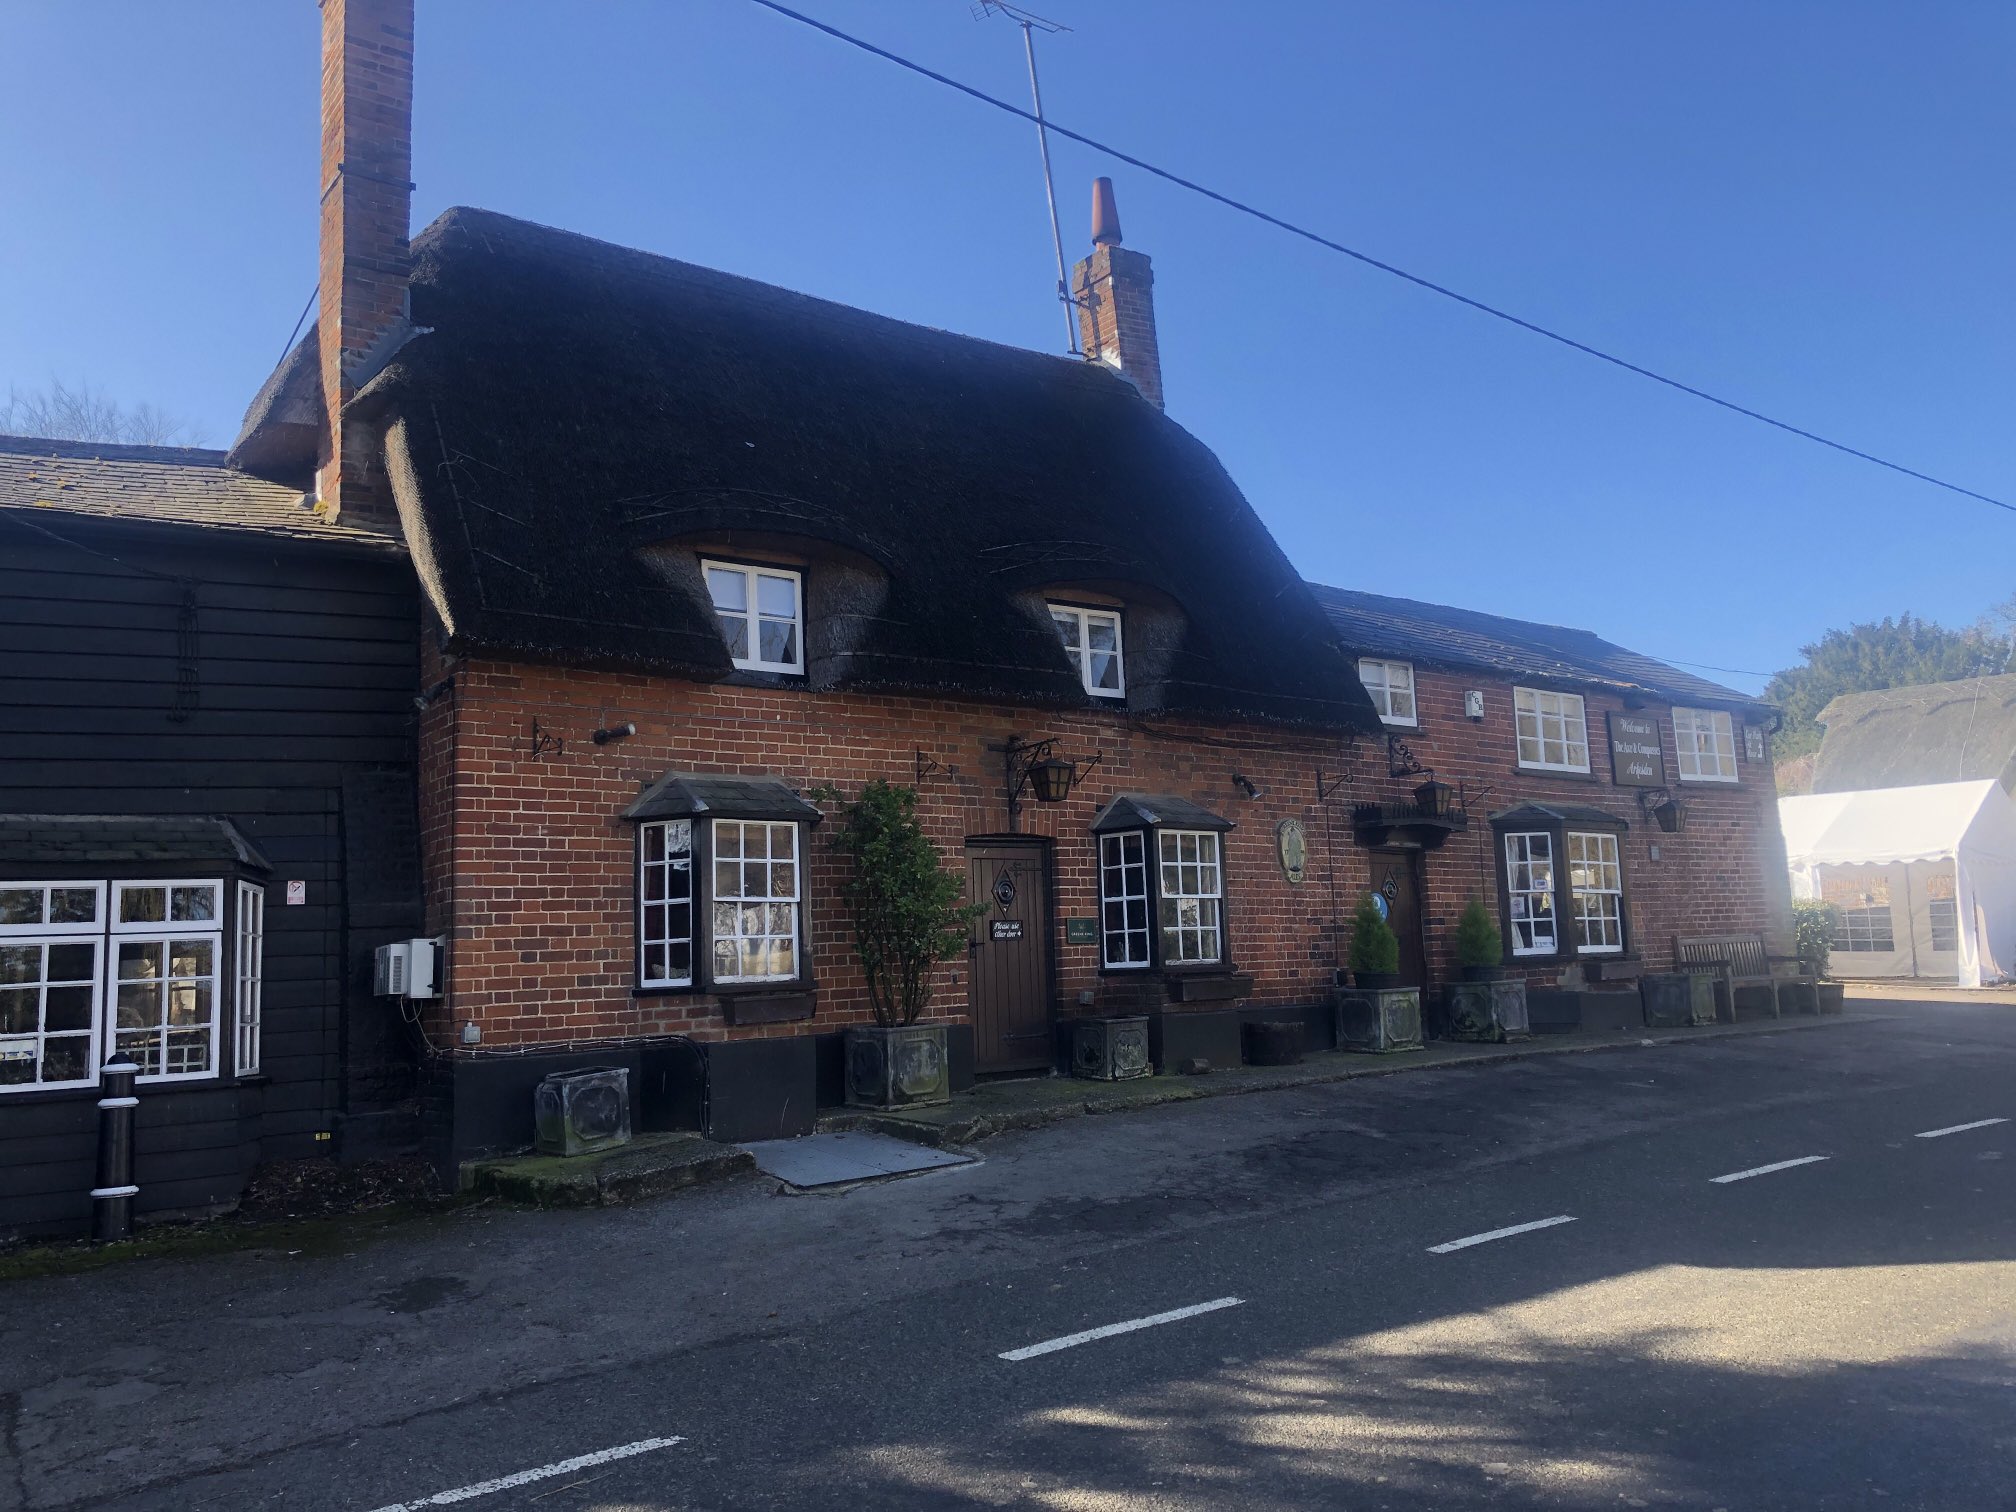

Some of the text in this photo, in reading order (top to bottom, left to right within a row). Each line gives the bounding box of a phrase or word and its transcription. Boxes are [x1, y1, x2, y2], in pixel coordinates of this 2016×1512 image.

[1620, 718, 1651, 734] Welcome to
[1614, 740, 1623, 752] The
[993, 922, 1019, 930] Please use
[994, 930, 1006, 938] other
